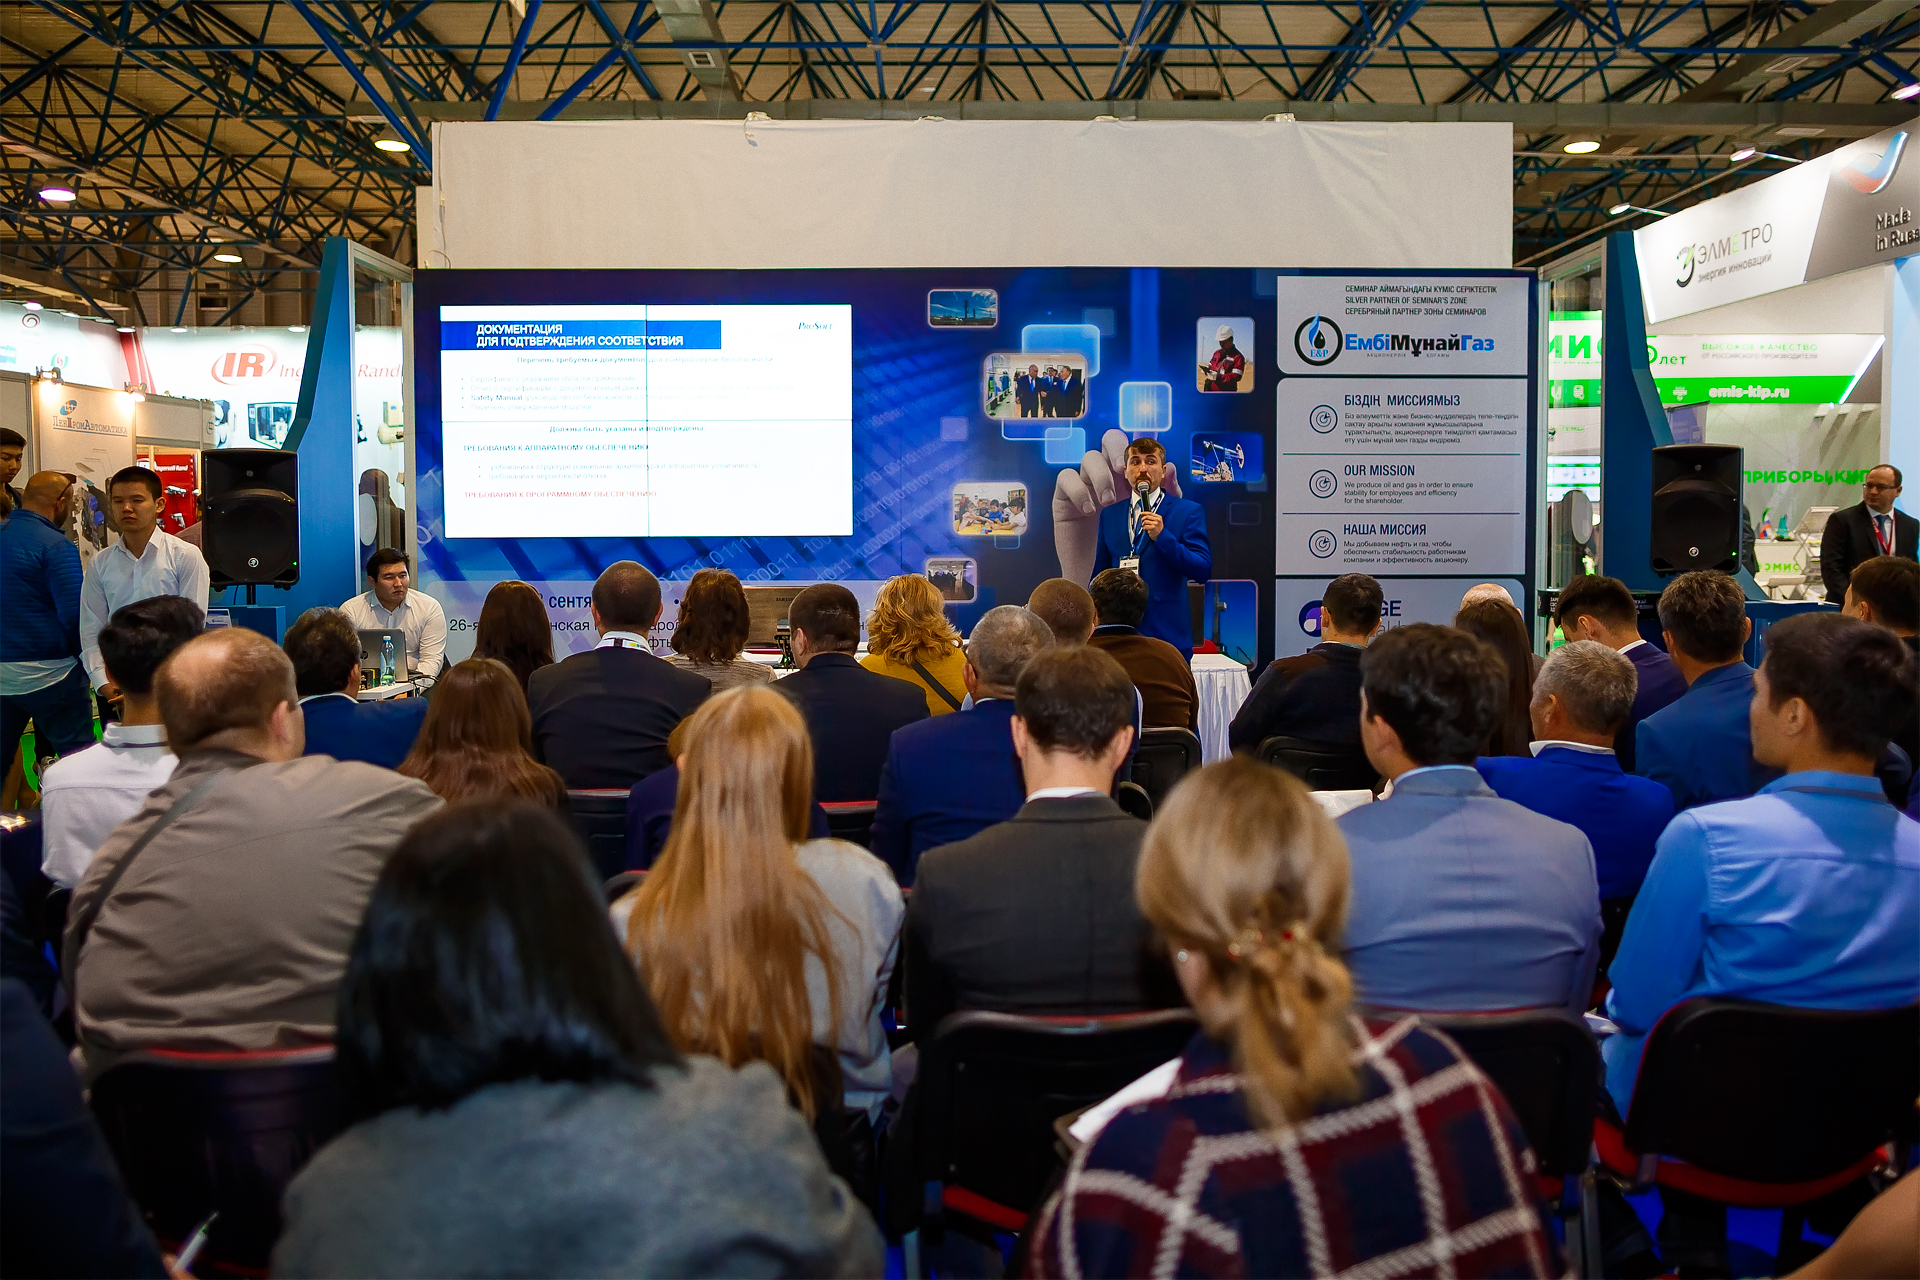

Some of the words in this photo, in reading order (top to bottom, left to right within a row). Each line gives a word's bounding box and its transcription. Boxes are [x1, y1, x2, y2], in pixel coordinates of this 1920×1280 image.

[1875, 206, 1911, 231] Made
[1697, 223, 1773, 265] ЭЛМЕТРО
[1875, 234, 1889, 251] in
[1890, 228, 1920, 248] Russ
[1697, 266, 1727, 283] энергия
[1728, 250, 1773, 274] инноваций
[1345, 296, 1368, 304] SILVER
[1369, 296, 1400, 304] PARTNER
[1401, 296, 1411, 304] OF
[1412, 296, 1449, 304] SEMINAR'S
[1450, 296, 1468, 304] ZONE
[1345, 306, 1391, 315] СЕРЕБРЯНЫЙ
[1392, 307, 1422, 315] ПАРТНЕР
[1445, 308, 1487, 316] СЕМИНАРОВ
[476, 323, 563, 336] ДОКУМЕНТАЦИЯ
[476, 336, 499, 348] ДЛЯ
[501, 336, 596, 348] ПОДТВЕРЖДЕНИЯ
[597, 335, 684, 346] СООТВЕТСТВИЯ
[1701, 342, 1756, 351] ВЫСОКОЕ
[1760, 342, 1818, 351] КАЧЕСТВО
[1310, 349, 1329, 357] E&P
[222, 353, 266, 377] IR
[1659, 355, 1687, 365] лет
[358, 364, 402, 377] Rand
[470, 394, 494, 402] Safety
[1709, 385, 1790, 400] emis-kip.ru
[1387, 394, 1460, 406] МИССИЯМЫЗ
[1344, 464, 1366, 476] OUR
[1369, 464, 1415, 476] MISSION
[1356, 482, 1382, 490] produce
[1379, 490, 1413, 498] employees
[1343, 524, 1377, 535] НАША
[1379, 524, 1427, 535] МИССИЯ
[549, 596, 592, 608] сентя
